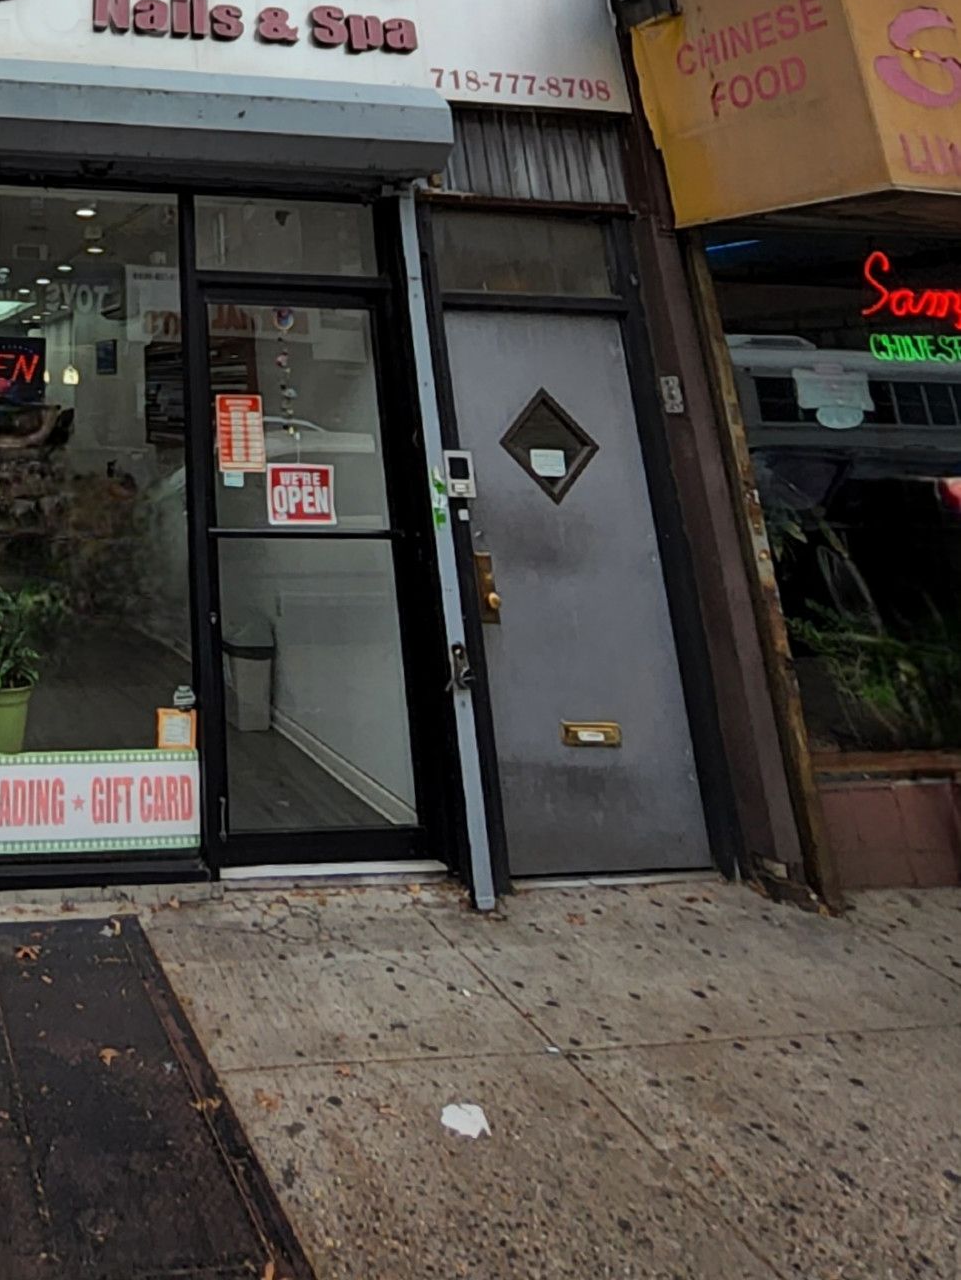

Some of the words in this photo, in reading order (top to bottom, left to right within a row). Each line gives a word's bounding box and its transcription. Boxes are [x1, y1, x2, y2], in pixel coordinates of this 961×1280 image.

[256, 6, 300, 46] &
[310, 4, 418, 55] Spa
[429, 68, 611, 102] 718-777-8798
[710, 56, 807, 118] FOOD
[279, 471, 321, 486] WE'RE
[273, 485, 330, 515] OPEN
[91, 776, 135, 825] GIFT
[139, 773, 194, 823] CARD
